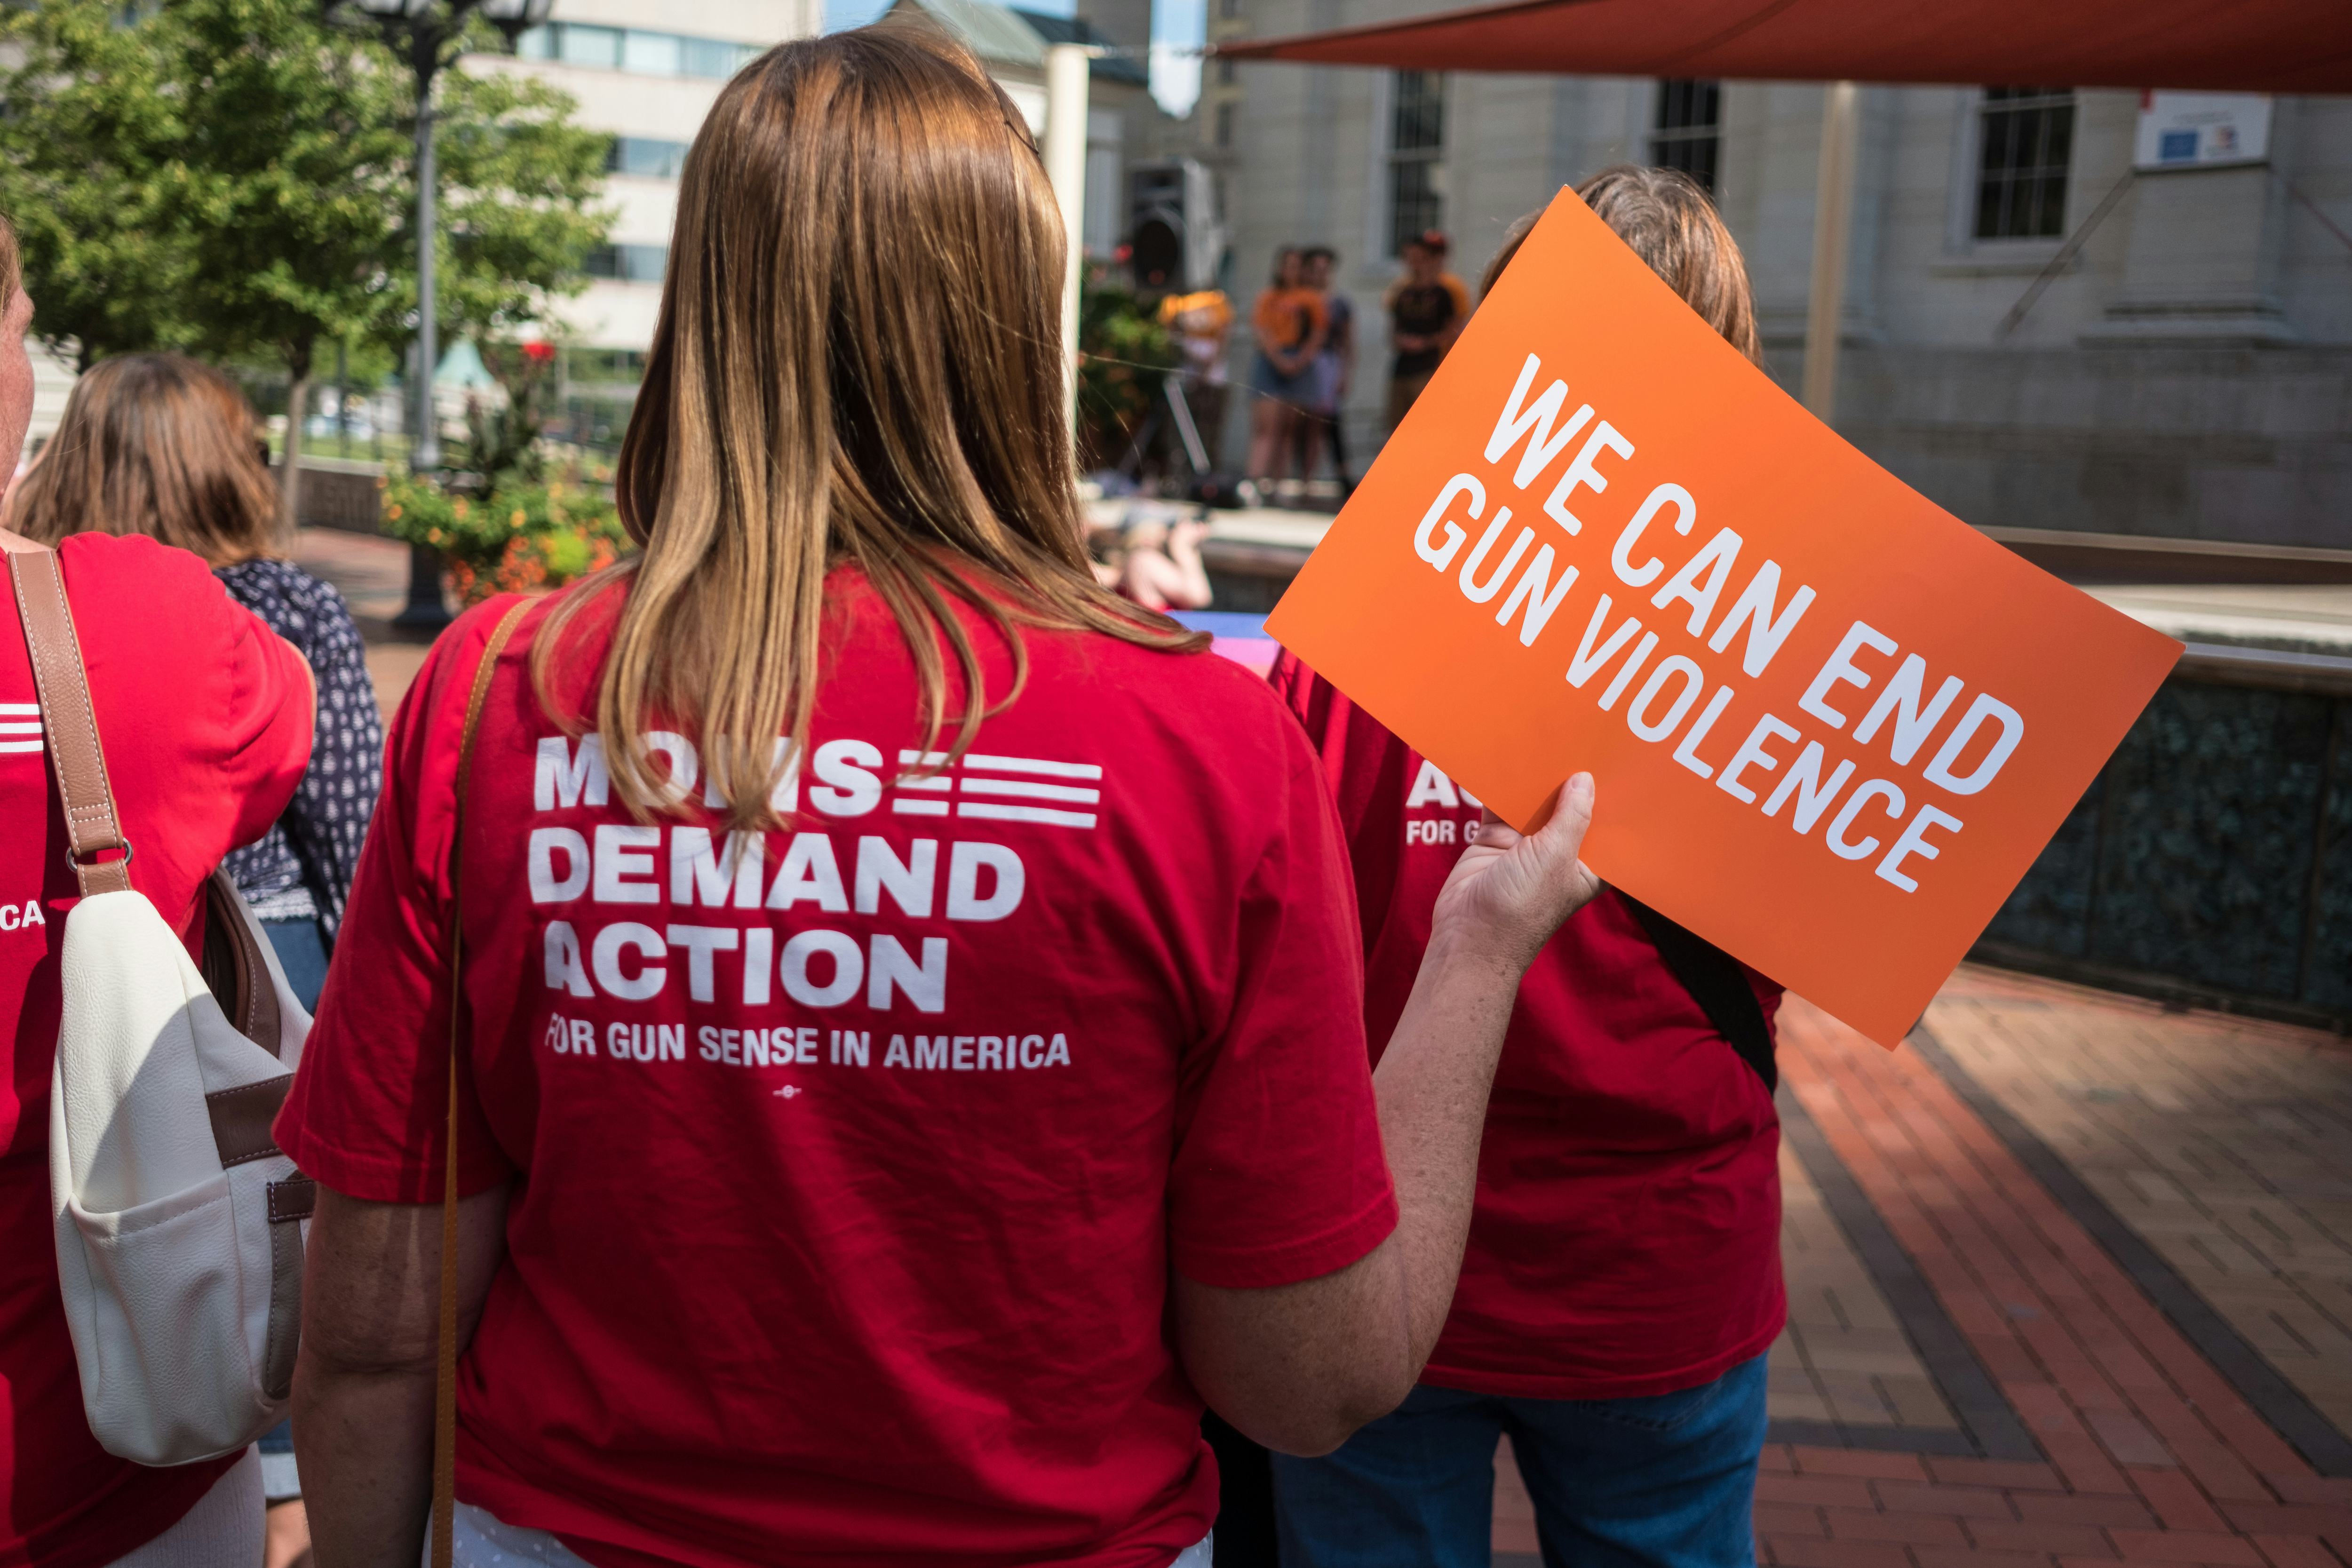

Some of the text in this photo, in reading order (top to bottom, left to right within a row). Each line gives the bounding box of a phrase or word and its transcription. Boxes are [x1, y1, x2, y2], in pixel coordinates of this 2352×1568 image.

[1484, 353, 2024, 795] WE CAN END
[1414, 473, 1963, 893] GUN VIOLENCE
[1406, 759, 1484, 808] A
[528, 825, 1025, 921] DEMAND
[1406, 820, 1456, 845] FOR
[544, 921, 948, 1013] ACTION
[544, 1012, 1071, 1071] FOR GUN SENSE IN AMERICA
